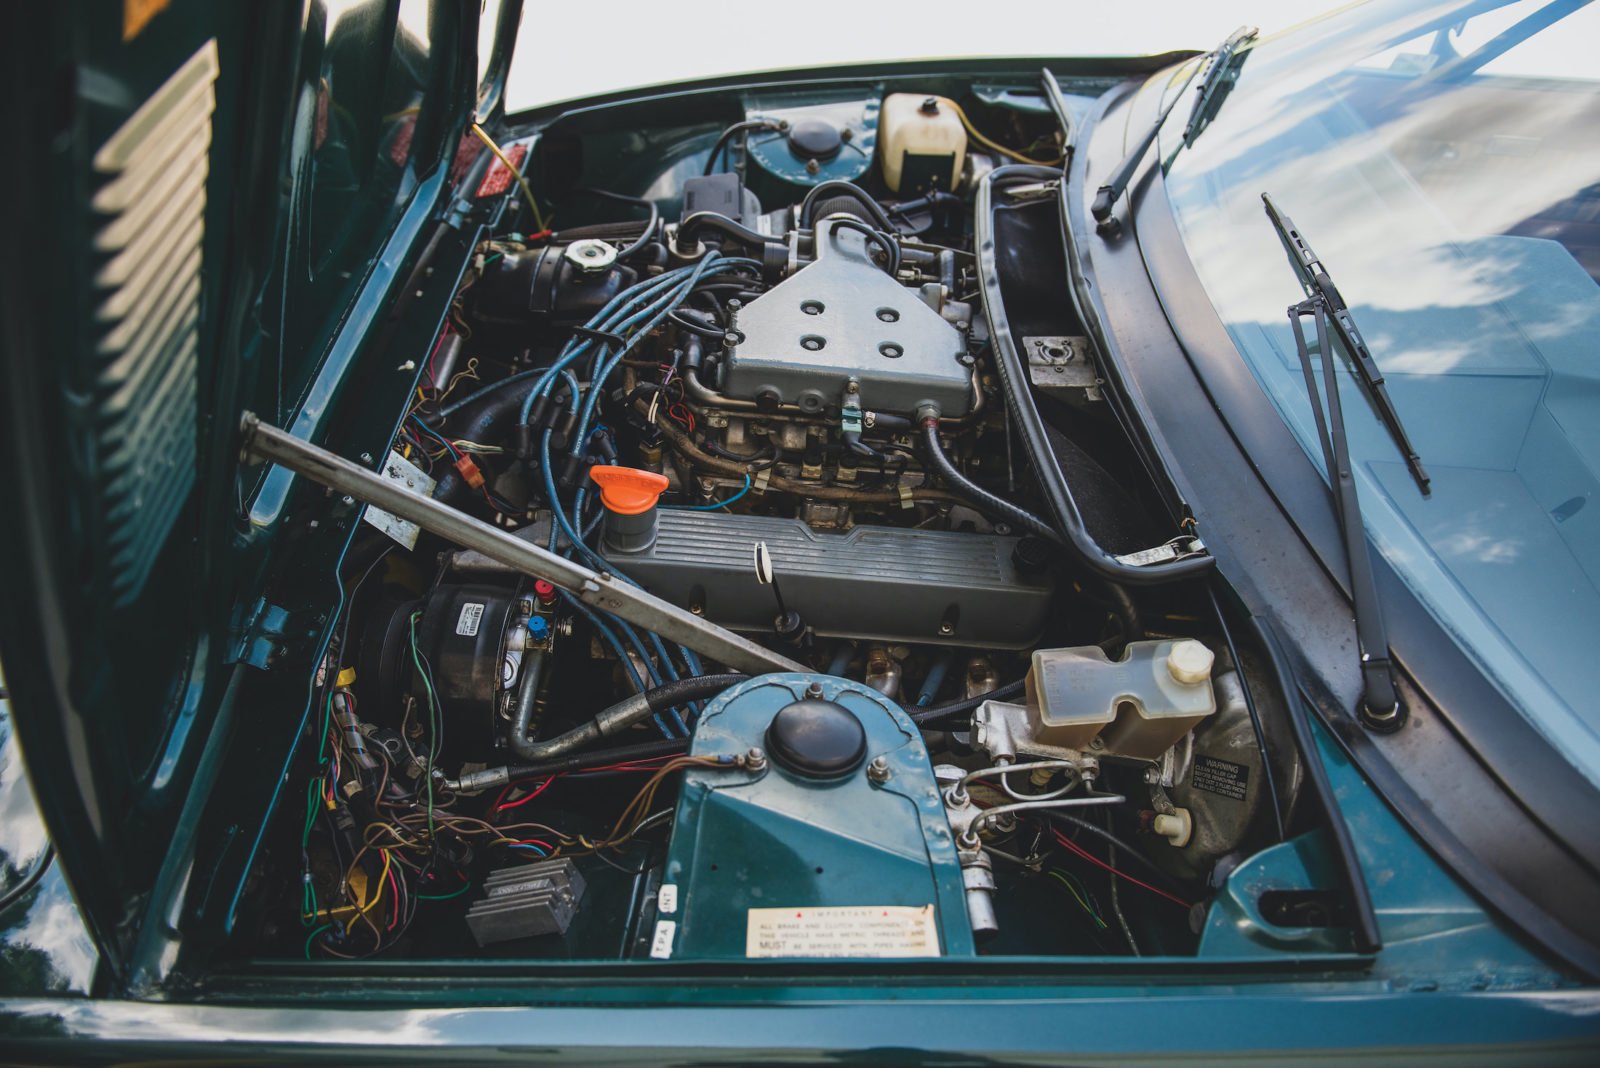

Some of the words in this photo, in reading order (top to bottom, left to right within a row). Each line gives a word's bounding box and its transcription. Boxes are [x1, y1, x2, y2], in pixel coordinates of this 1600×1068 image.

[1195, 765, 1211, 773] CLEAN
[1211, 768, 1226, 777] FILLER
[1206, 759, 1239, 774] WARNING
[1219, 782, 1232, 790] FLUID
[1232, 786, 1246, 794] FROM
[777, 922, 800, 930] BRAKE
[759, 940, 787, 951] MUST
